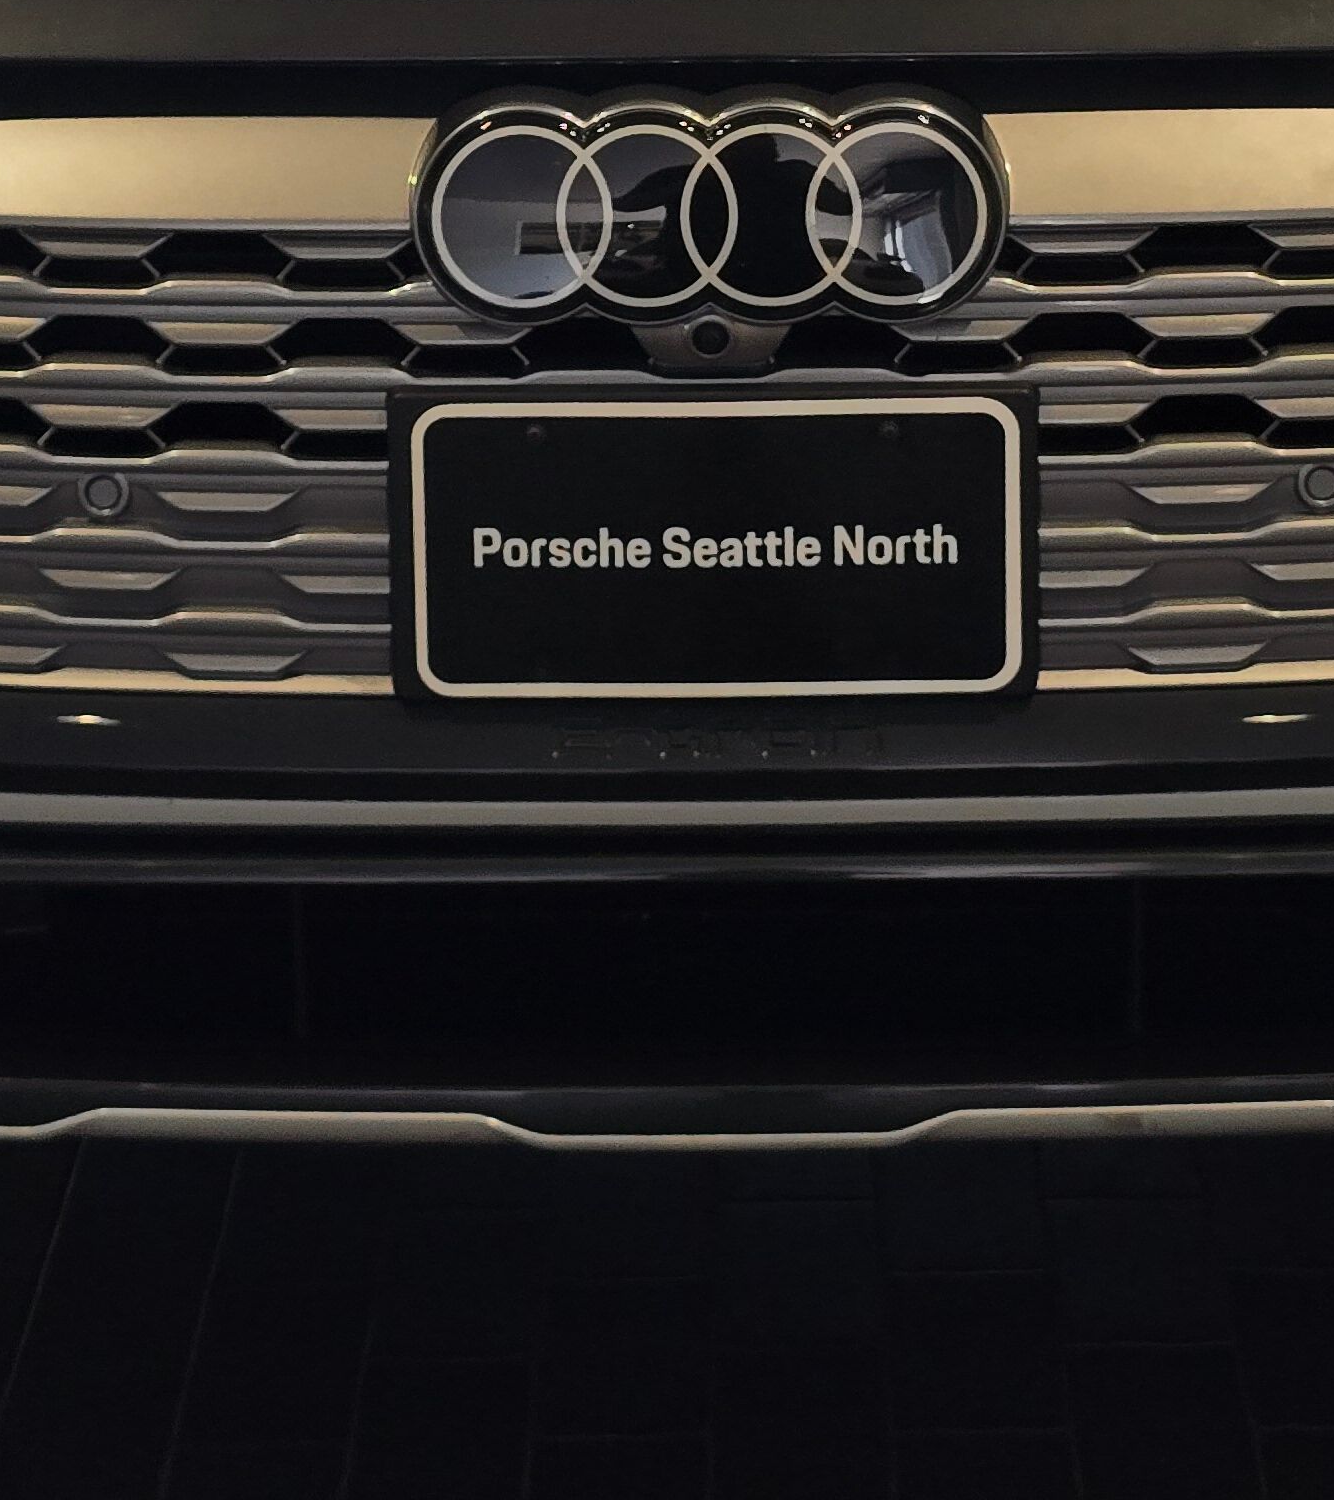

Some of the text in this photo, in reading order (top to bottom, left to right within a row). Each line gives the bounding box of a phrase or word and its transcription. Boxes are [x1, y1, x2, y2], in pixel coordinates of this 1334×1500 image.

[473, 523, 959, 569] Porsche Seattle North
